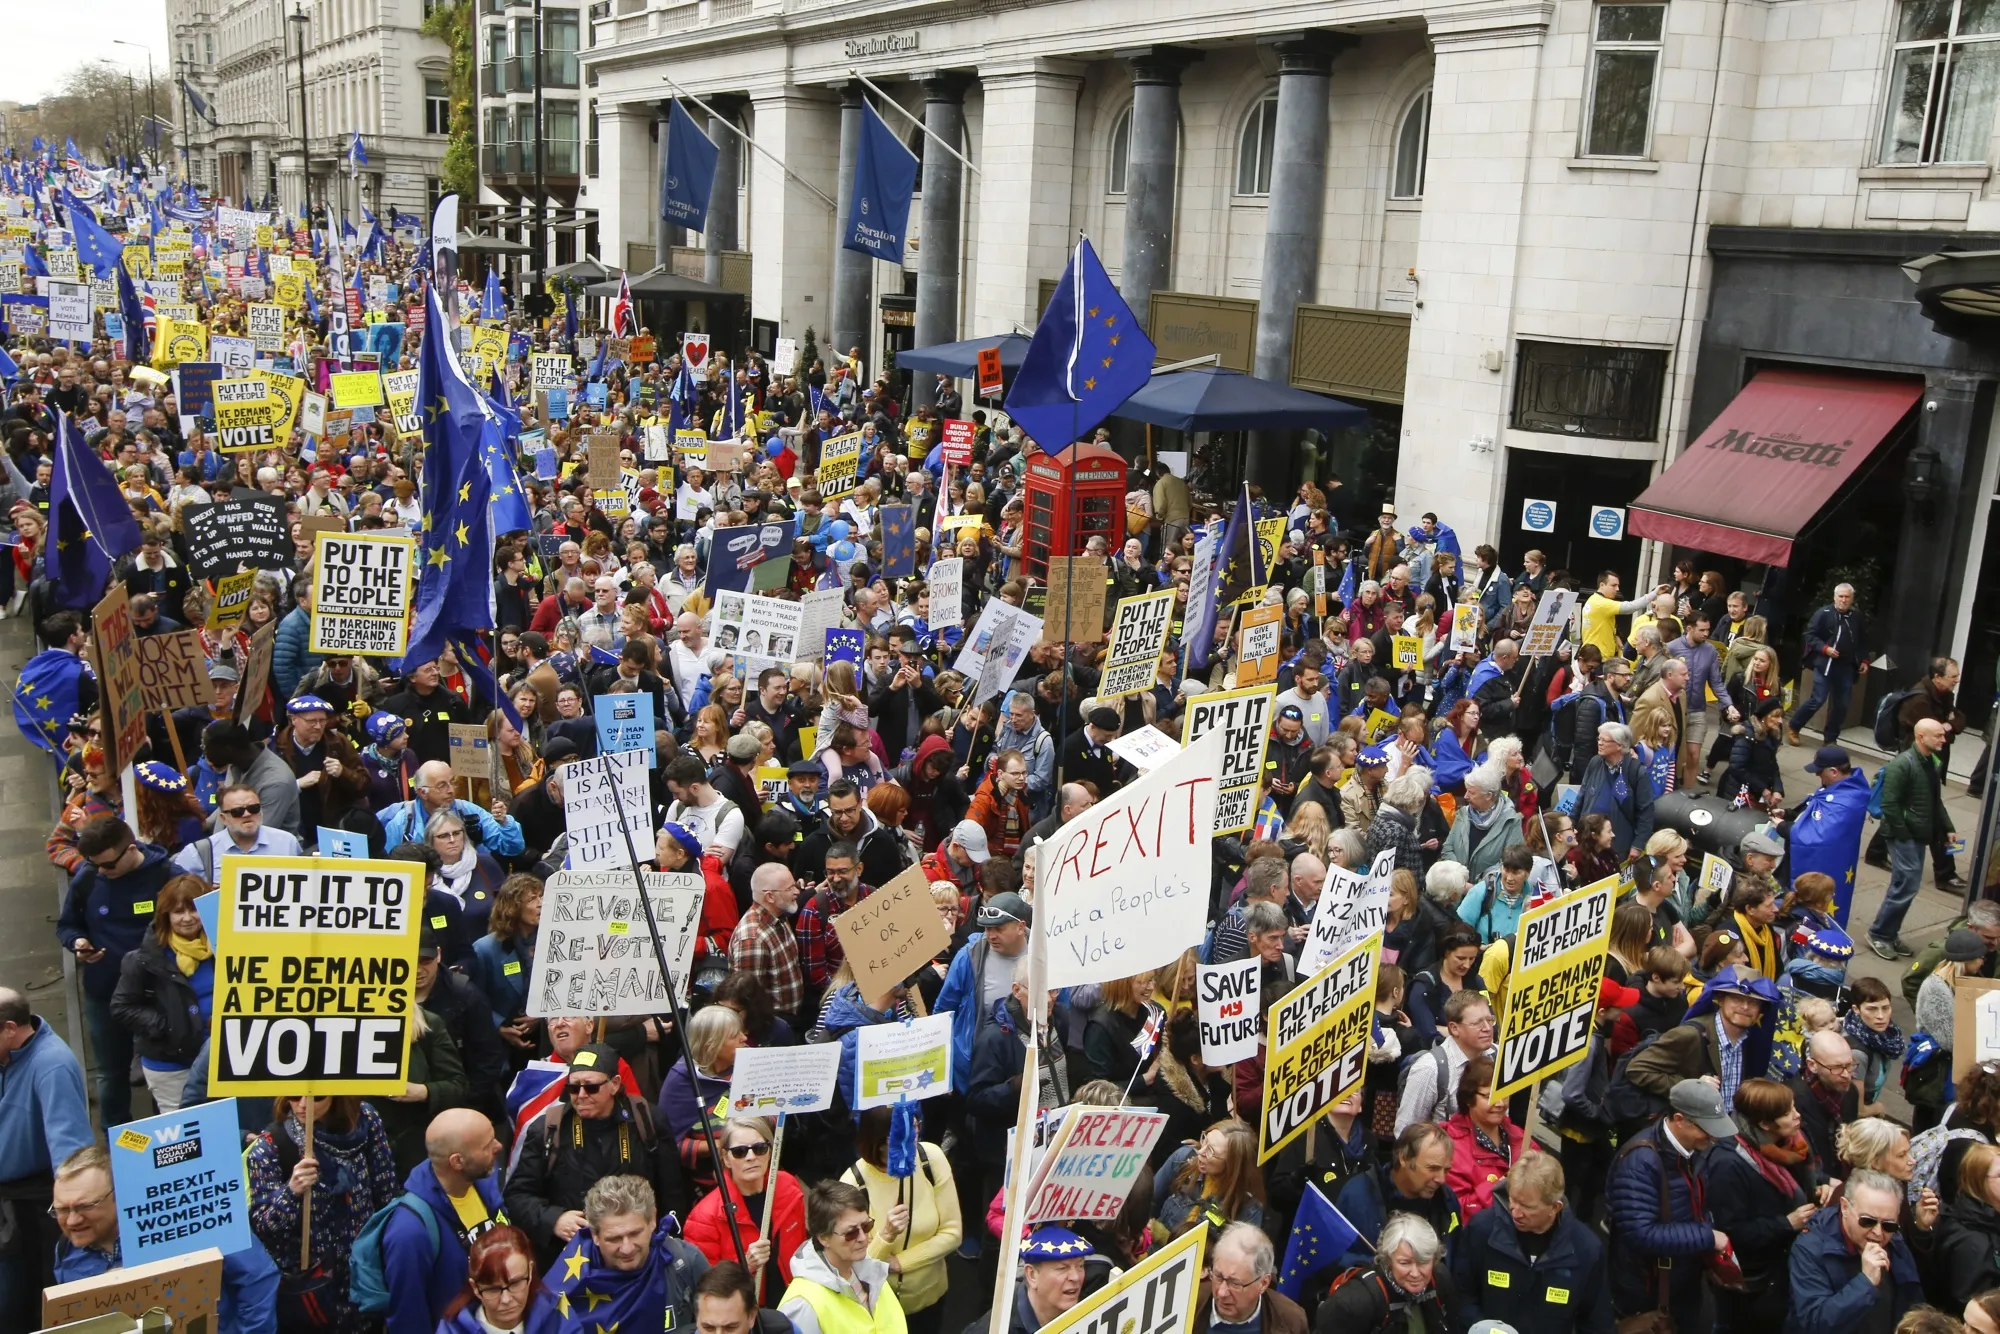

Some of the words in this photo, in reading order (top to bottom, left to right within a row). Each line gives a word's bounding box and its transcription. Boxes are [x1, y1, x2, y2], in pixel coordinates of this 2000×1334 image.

[845, 37, 886, 57] Sheraton
[887, 32, 919, 51] Grand
[854, 233, 881, 249] Grand
[857, 222, 896, 242] Sheraton
[57, 322, 84, 332] VOTE
[212, 337, 255, 349] DEMOCRACY
[214, 351, 251, 368] LIES
[536, 358, 555, 367] PUT
[558, 358, 568, 367] IT
[984, 352, 996, 362] May
[535, 376, 566, 385] PEOPLE
[536, 367, 547, 376] TO
[550, 368, 567, 377] THE
[217, 384, 236, 395] PUT
[241, 383, 251, 393] IT
[254, 382, 265, 392] TO
[218, 393, 234, 402] THE
[236, 389, 266, 401] PEOPLE
[337, 387, 364, 398] REVOKE
[218, 408, 232, 419] WE
[234, 407, 271, 417] DEMAND
[219, 418, 226, 428] A
[228, 416, 272, 427] PEOPLE'S
[221, 425, 273, 447] VOTE
[950, 423, 968, 431] BUILD
[943, 442, 971, 450] BORDERS
[1705, 429, 1853, 467] Musetti
[1076, 471, 1117, 479] ELEPHONE
[190, 507, 216, 525] BREXIT
[224, 503, 241, 511] HAS
[253, 502, 276, 513] BEEN
[216, 512, 254, 524] SPAFFED
[206, 529, 217, 539] UP
[228, 525, 245, 533] THE
[252, 524, 277, 532] WALL!
[193, 547, 208, 560] IT'S
[209, 539, 229, 551] TIME
[248, 536, 273, 546] WASH
[202, 555, 220, 568] OUR
[226, 550, 254, 560] HANDS
[257, 550, 270, 558] OF
[273, 552, 284, 561] IT!
[325, 541, 373, 566] PUT
[381, 546, 404, 568] IT
[324, 564, 351, 586] TO
[359, 567, 402, 589] THE
[322, 584, 400, 607] PEOPLE
[752, 598, 769, 607] MEET
[772, 602, 802, 613] THERESA
[351, 607, 384, 616] PEOPLE'S
[385, 609, 404, 617] VOTE
[751, 608, 772, 618] MAY'S
[776, 611, 798, 622] TRADE
[931, 606, 957, 624] EUROPE
[321, 617, 336, 627] I'M
[339, 618, 397, 631] MARCHING
[321, 627, 335, 639] TO
[339, 629, 385, 641] DEMAND
[388, 631, 396, 642] A
[750, 618, 799, 632] NEGOTIATORS!
[1254, 625, 1269, 635] GIVE
[320, 638, 367, 650] PEOPLES
[370, 641, 395, 651] VOTE
[1249, 632, 1273, 644] PEOPLE
[1254, 641, 1267, 650] THE
[1243, 650, 1263, 661] FINAL
[1263, 645, 1276, 655] SAY
[1399, 651, 1417, 664] VOTE
[566, 750, 645, 780] BREXIT
[577, 780, 591, 795] IS
[598, 771, 624, 789] AN
[568, 812, 650, 848] STITCH
[1044, 777, 1212, 896] REXIT
[581, 841, 612, 863] UP
[239, 873, 308, 903] PUT
[320, 875, 352, 904] IT
[365, 876, 404, 906] TO
[557, 872, 632, 887] DISASTER
[643, 872, 693, 887] AHEAD
[1089, 909, 1104, 922] a
[1111, 873, 1190, 915] People's
[238, 905, 290, 928] THE
[299, 905, 402, 930] PEOPLE
[851, 884, 911, 936] REVOKE
[1525, 911, 1561, 948] PUT
[1564, 902, 1583, 932] IT
[1587, 892, 1608, 924] TO
[880, 922, 900, 942] OR
[1523, 940, 1550, 968] THE
[1553, 916, 1604, 955] PEOPLE
[868, 928, 924, 974] RE-VOTE
[1070, 931, 1126, 967] Vote
[225, 955, 269, 985] WE
[281, 955, 410, 985] DEMAND
[1201, 966, 1258, 1003] SAVE
[1279, 986, 1318, 1029] PUT
[1323, 967, 1342, 999] IT
[1348, 951, 1370, 981] TO
[1511, 984, 1535, 1014] WE
[1537, 953, 1603, 1002] DEMAND
[222, 986, 242, 1013] A
[253, 986, 408, 1014] PEOPLE'S
[1219, 1000, 1243, 1019] MY
[1277, 1014, 1307, 1047] THE
[1311, 969, 1369, 1024] PEOPLE
[1506, 1014, 1517, 1038] A
[1520, 977, 1599, 1031] PEOPLE'S
[1200, 1012, 1261, 1047] FUTURE
[225, 1017, 402, 1077] VOTE
[1270, 1056, 1295, 1089] WE
[1300, 1000, 1372, 1061] DEMAND
[1502, 1000, 1594, 1084] VOTE
[1267, 1088, 1279, 1109] A
[1284, 1019, 1369, 1096] PEOPLE'S
[1268, 1038, 1365, 1144] VOTE
[1067, 1113, 1162, 1148] BREXIT
[155, 1140, 196, 1156] WOMEN'S
[156, 1145, 199, 1162] EQUALITY
[157, 1155, 188, 1167] PARTY.
[1052, 1153, 1115, 1179] MAKES
[1111, 1153, 1143, 1179] US
[146, 1170, 216, 1200] BREXIT
[123, 1179, 240, 1220] THREATENS
[1028, 1183, 1123, 1221] SMALLER
[136, 1196, 231, 1232] WOMEN'S
[138, 1211, 233, 1248] FREEDOM
[94, 1285, 151, 1309] WANT
[160, 1277, 181, 1293] MY
[1140, 1257, 1187, 1334] IT
